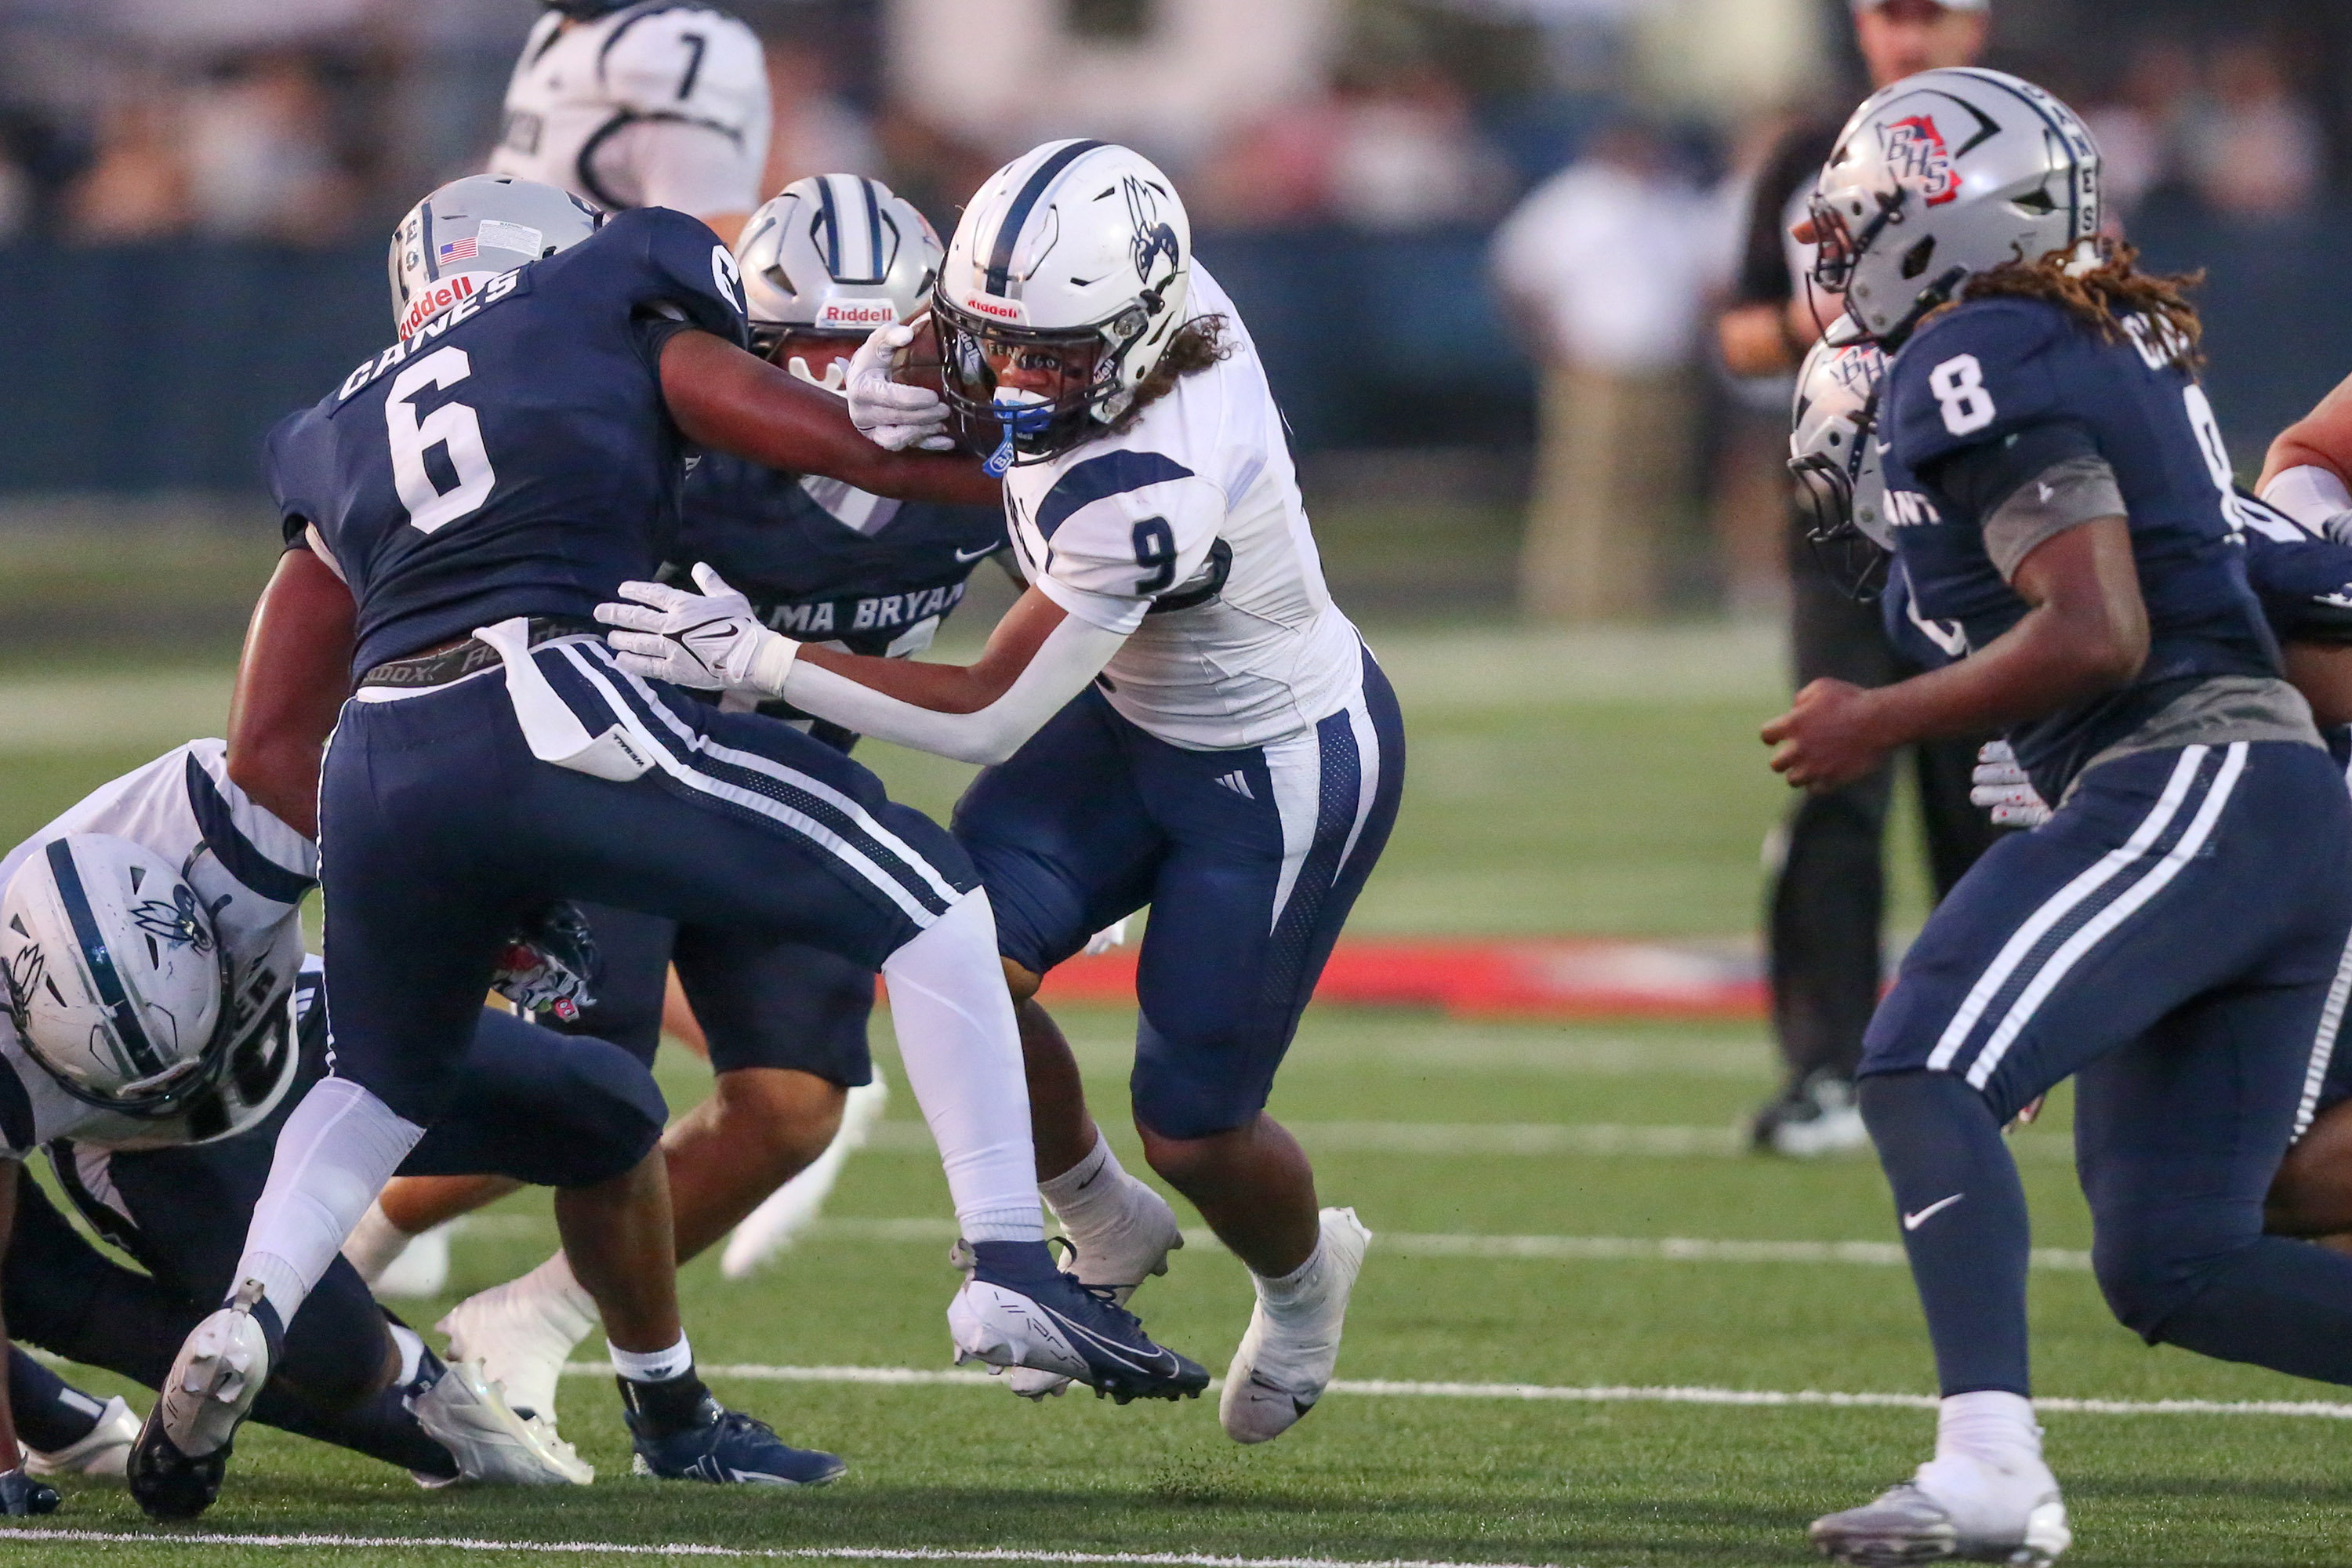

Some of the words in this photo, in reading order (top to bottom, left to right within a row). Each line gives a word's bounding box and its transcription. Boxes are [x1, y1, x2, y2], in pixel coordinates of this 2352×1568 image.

[680, 32, 706, 100] 7
[1887, 128, 1949, 194] BHS
[339, 268, 521, 401] CANES
[400, 276, 474, 342] Riddell
[826, 306, 892, 321] Riddell
[1929, 354, 1996, 436] 8
[384, 345, 495, 535] 6
[1133, 517, 1176, 596] 9
[767, 601, 835, 632] MA
